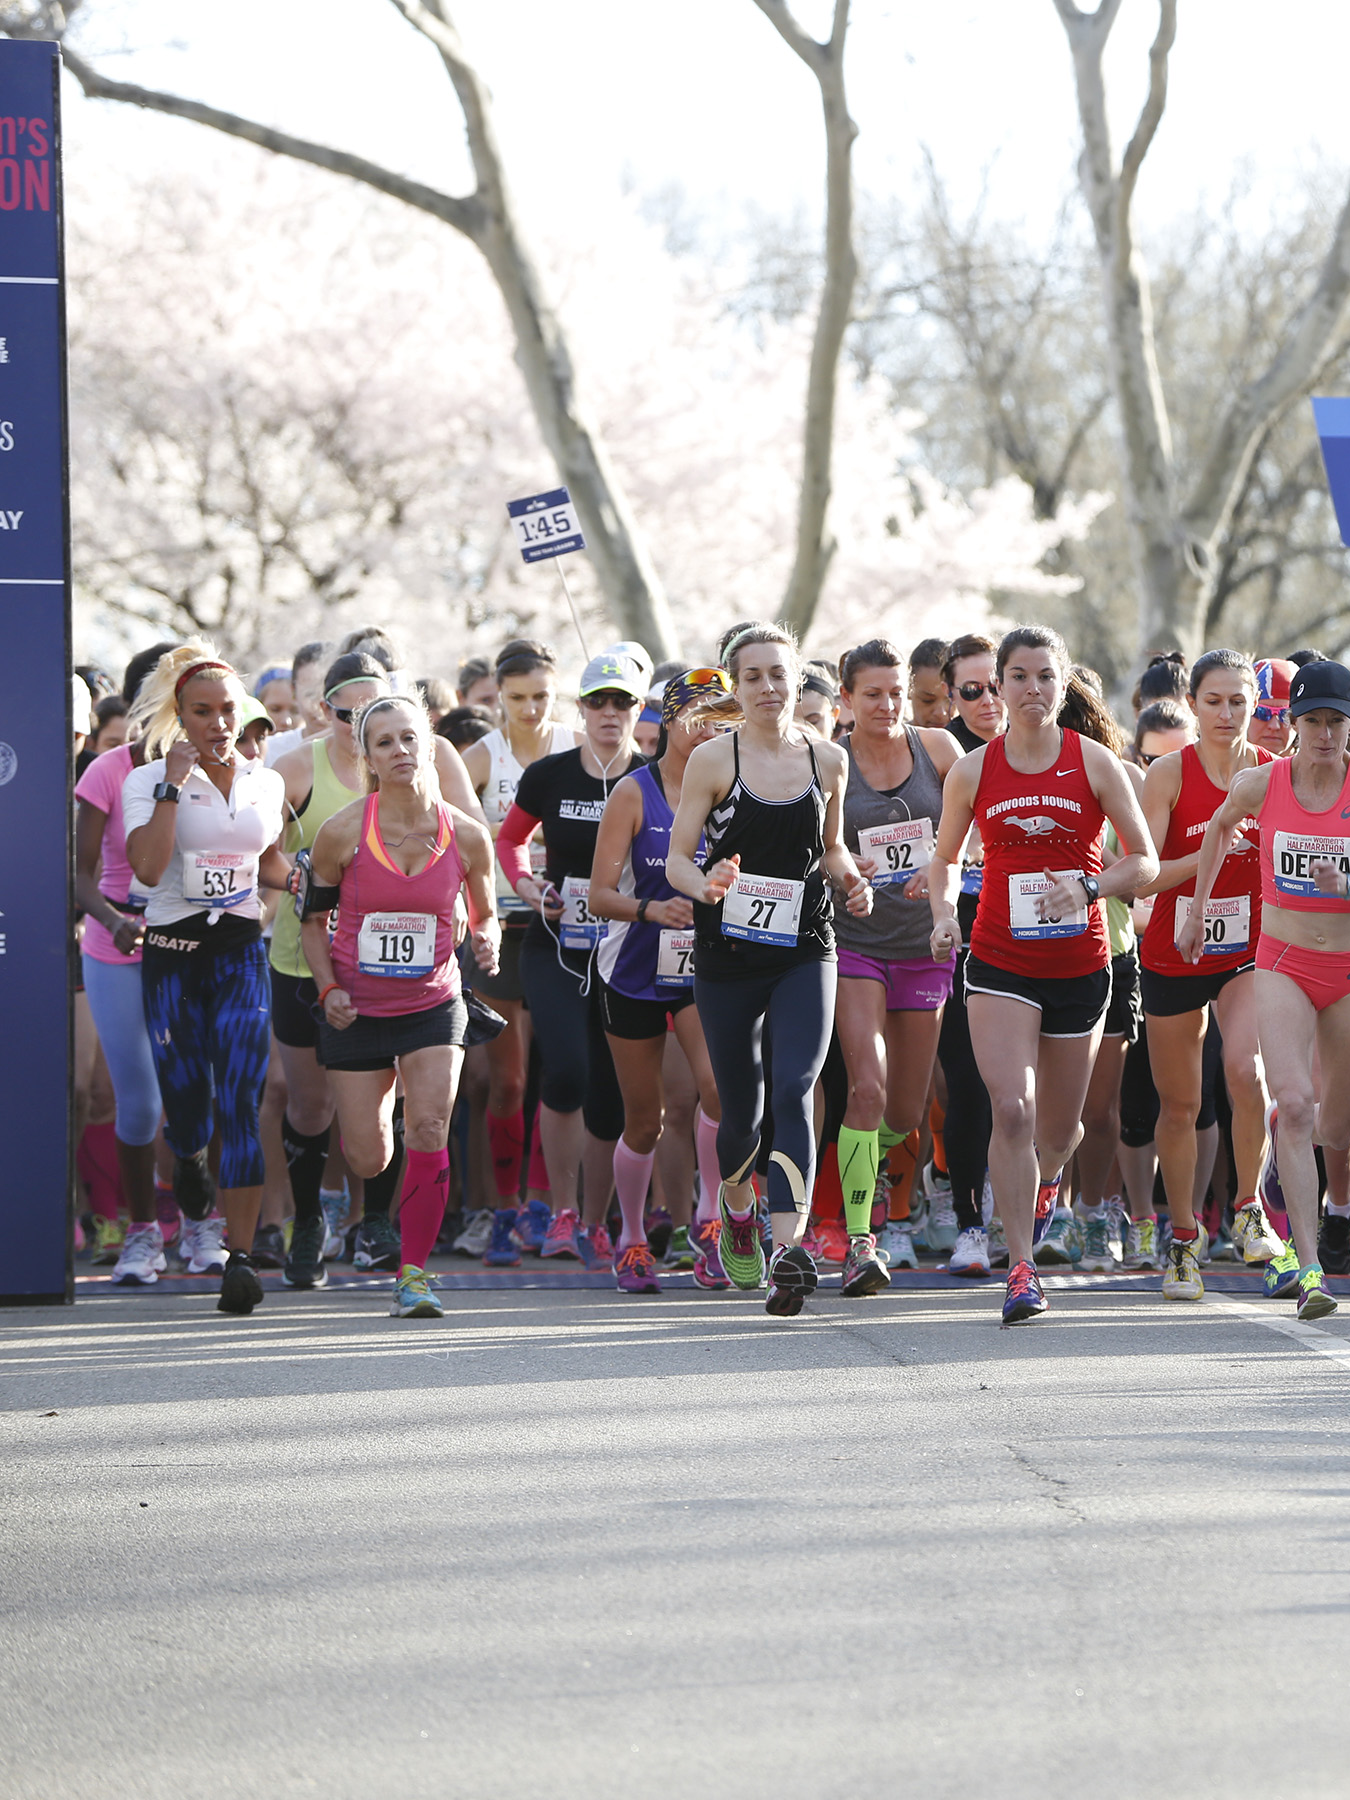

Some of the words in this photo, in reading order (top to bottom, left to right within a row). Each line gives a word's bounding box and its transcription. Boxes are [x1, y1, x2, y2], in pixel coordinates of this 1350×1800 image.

[519, 511, 571, 542] 1:45
[560, 804, 581, 815] HALF
[986, 796, 1040, 820] HENWOODS
[1041, 795, 1082, 815] HOUNDS
[870, 835, 886, 845] HALF
[886, 829, 923, 841] MARATHON
[1287, 840, 1304, 849] HALF
[1305, 843, 1345, 853] MARATHON
[1313, 837, 1344, 845] women's
[886, 843, 913, 870] 92
[1281, 851, 1350, 879] DEEA
[204, 870, 237, 897] 532
[738, 883, 754, 894] HALF
[755, 887, 794, 899] MARATHON
[1020, 883, 1037, 893] HALF
[748, 899, 777, 929] 27
[371, 922, 388, 930] HALF
[388, 922, 427, 931] MARATHON
[148, 932, 200, 952] USATF
[379, 935, 414, 963] 119
